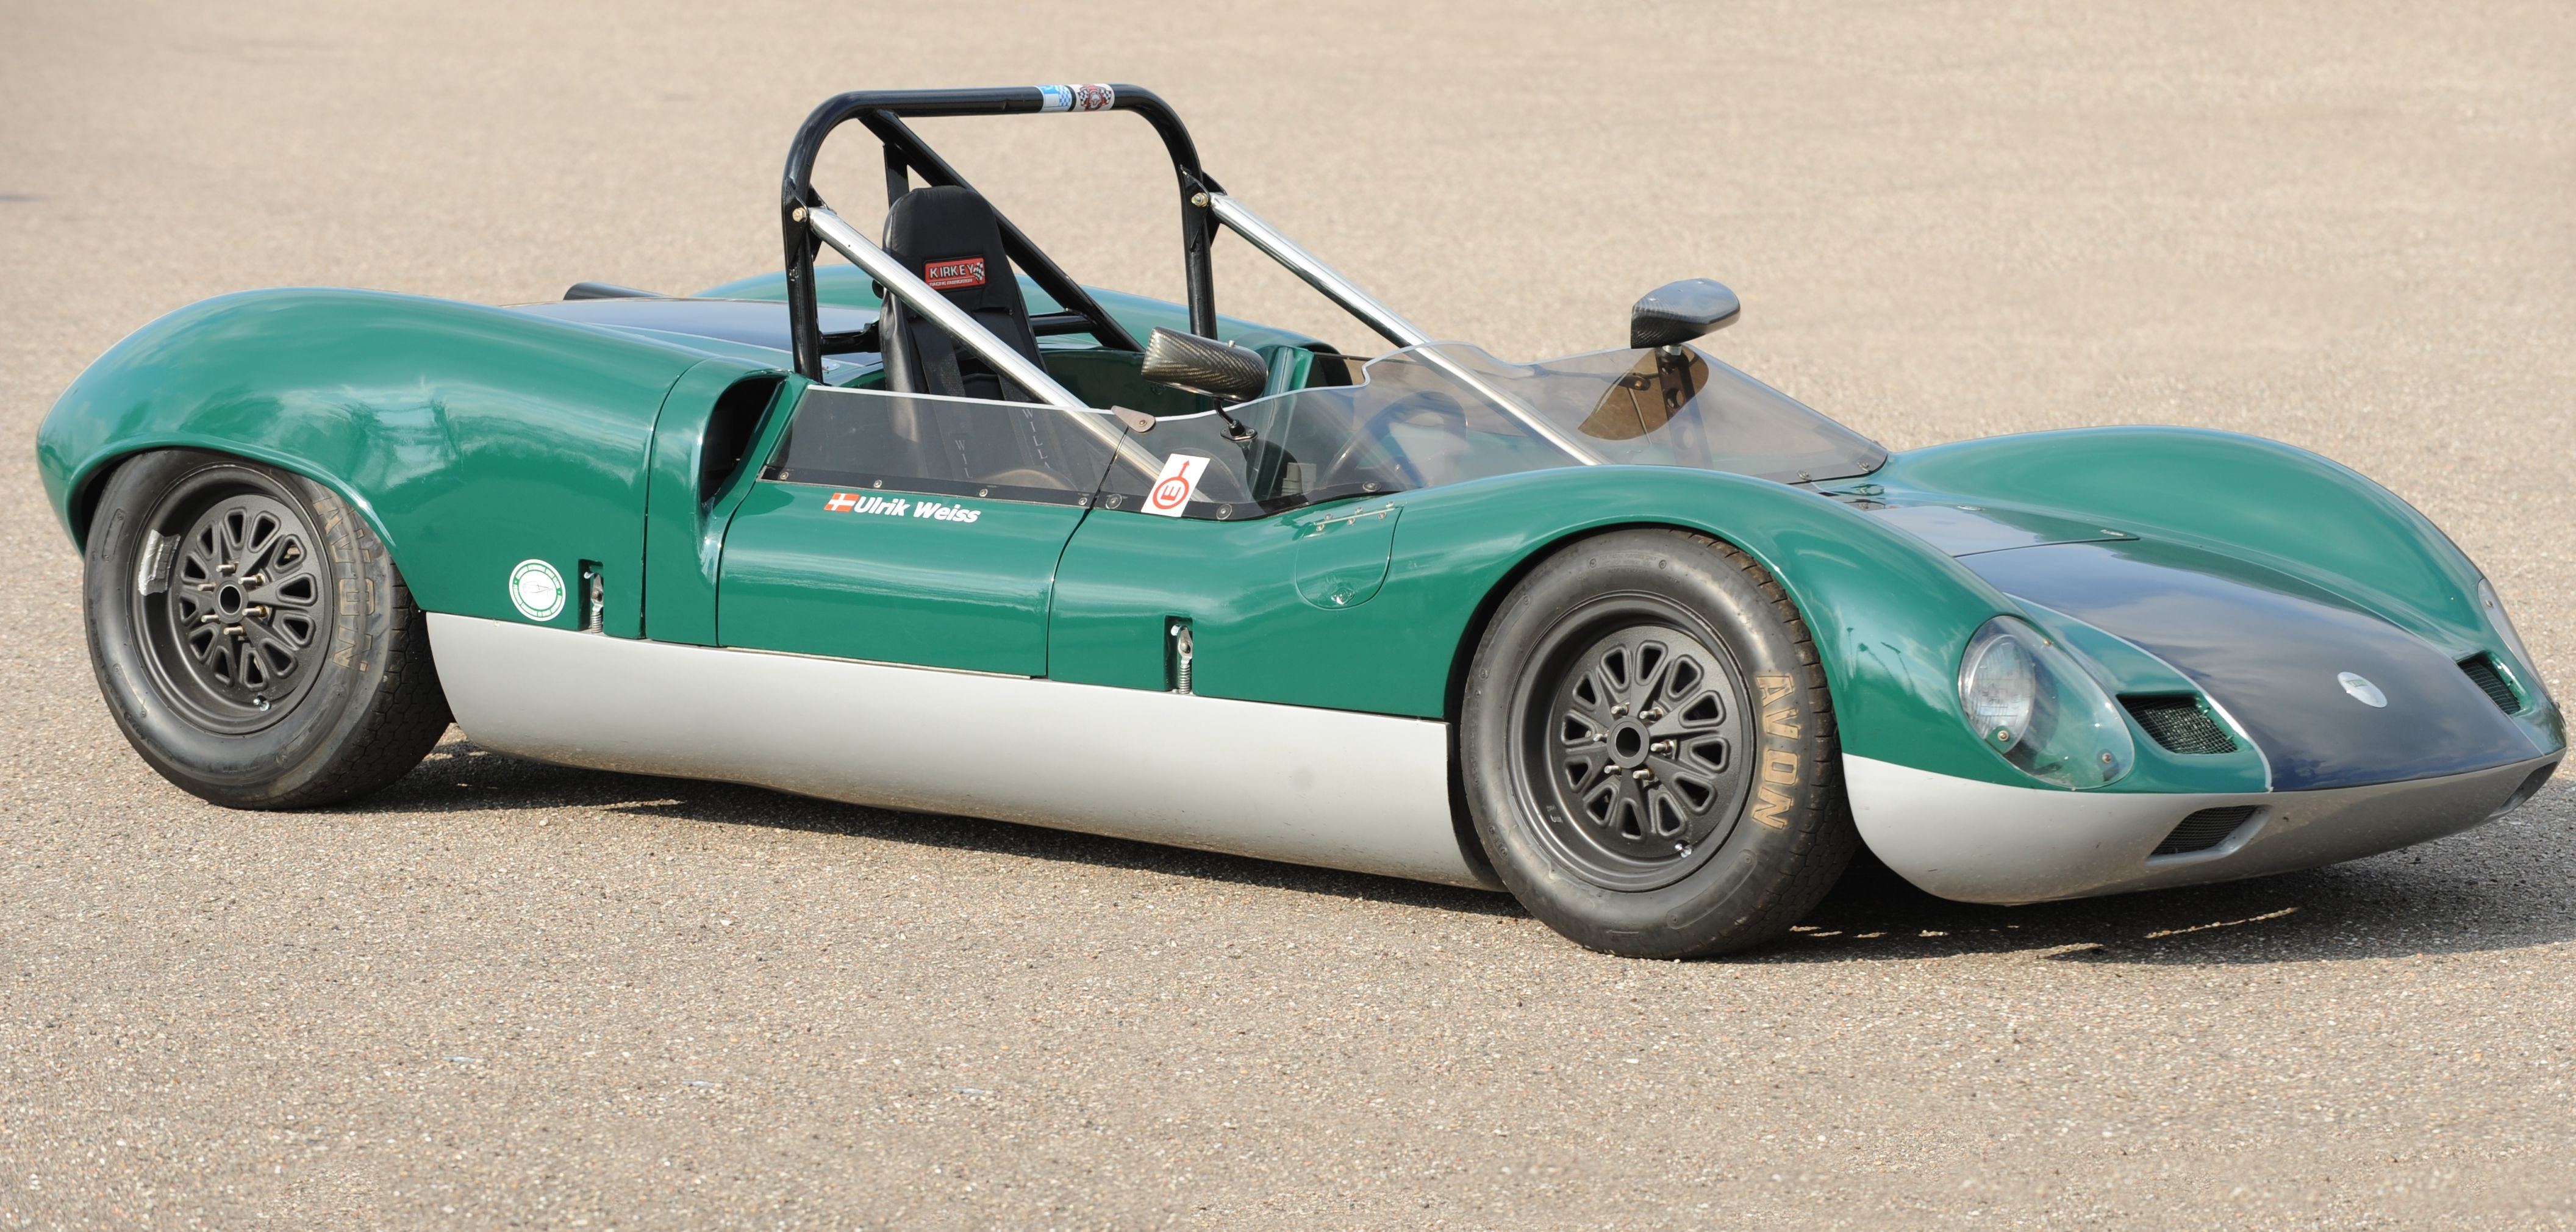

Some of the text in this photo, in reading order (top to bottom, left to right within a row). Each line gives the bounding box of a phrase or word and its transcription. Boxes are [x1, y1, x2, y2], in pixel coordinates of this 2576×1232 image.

[930, 264, 974, 279] KIRKEY
[854, 496, 981, 523] Ulrik Weiss
[1752, 676, 1799, 830] AVON
